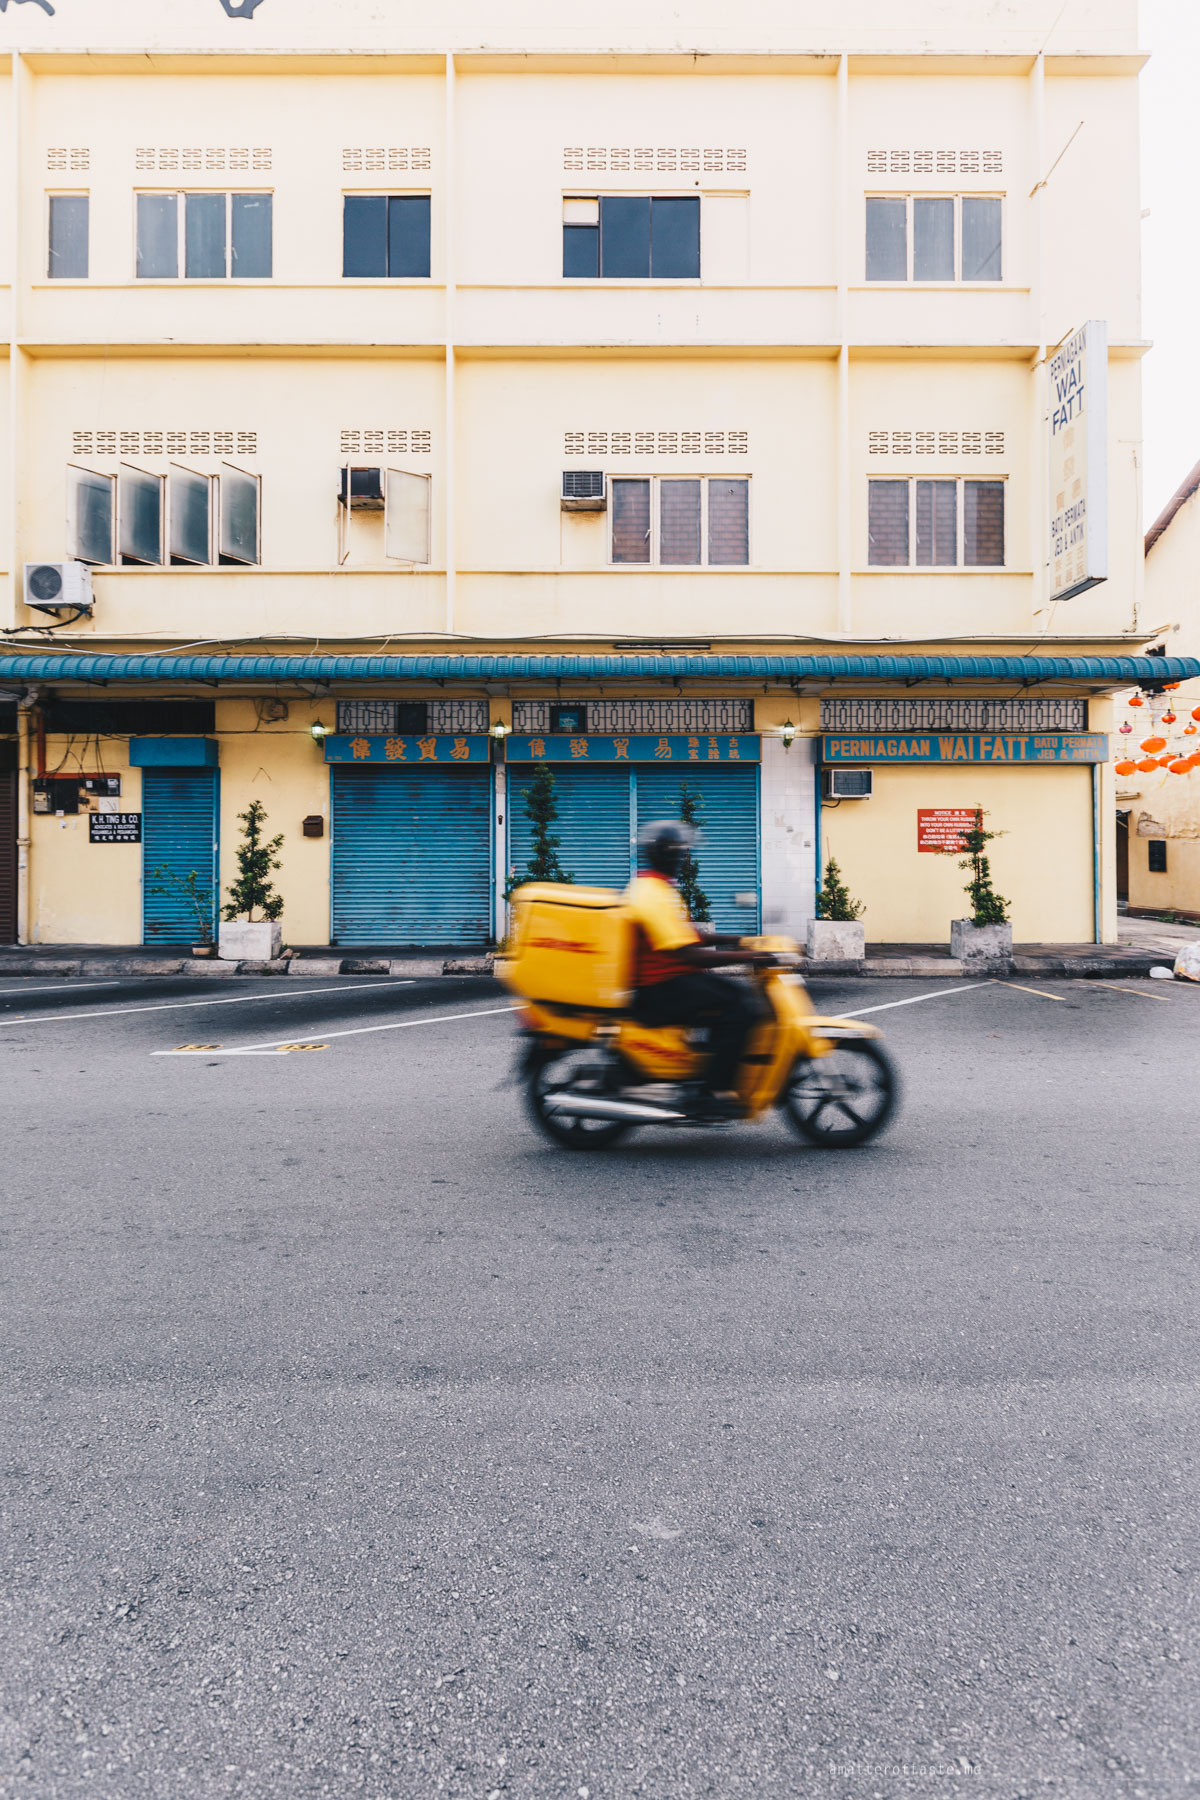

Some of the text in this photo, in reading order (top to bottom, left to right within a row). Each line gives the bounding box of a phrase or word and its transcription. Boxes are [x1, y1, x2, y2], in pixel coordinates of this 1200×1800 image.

[1051, 327, 1086, 384] PERNIAGAAN
[1056, 360, 1081, 403] WAI
[1053, 385, 1084, 436] FATT
[348, 737, 470, 761] 偉發貿易
[528, 737, 672, 760] 偉發貿易
[830, 736, 1029, 760] PERNIAGAAN WAI FATT
[1034, 737, 1058, 748] BATU
[1037, 749, 1055, 759] JED
[1060, 749, 1068, 759] &
[105, 815, 120, 824] TING
[121, 815, 127, 824] &
